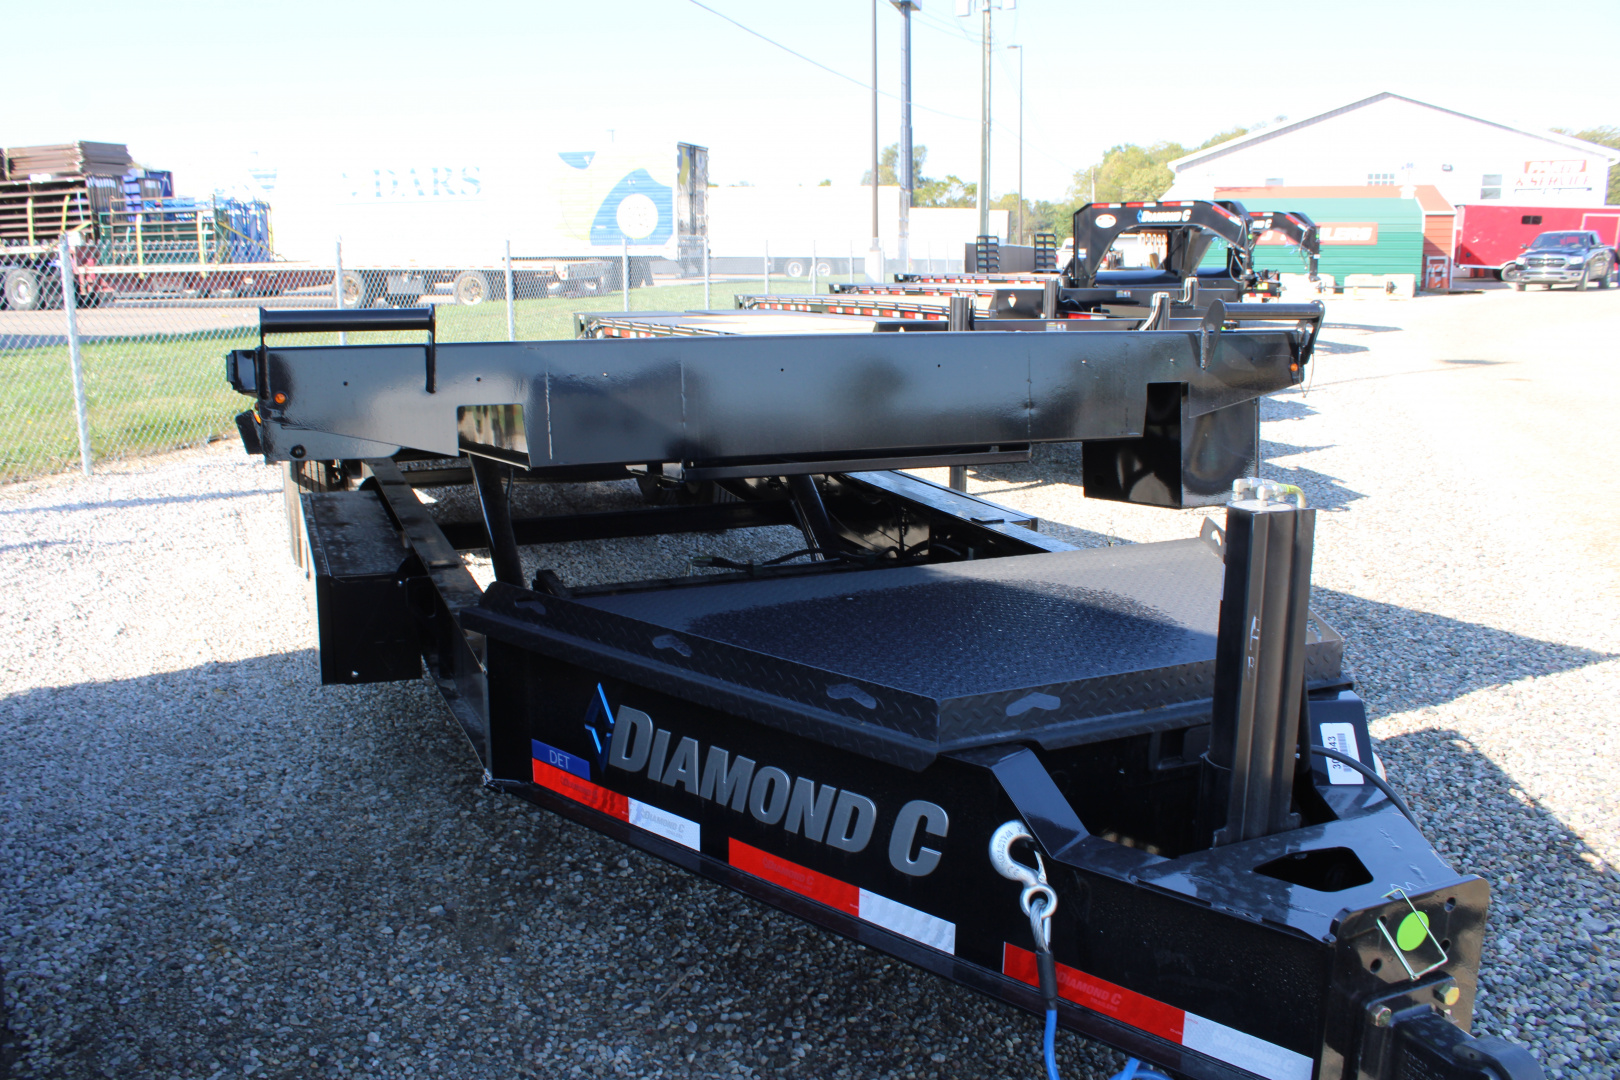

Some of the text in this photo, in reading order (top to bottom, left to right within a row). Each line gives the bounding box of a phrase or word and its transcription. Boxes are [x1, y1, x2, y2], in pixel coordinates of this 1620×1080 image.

[1182, 208, 1192, 222] C
[549, 749, 571, 770] DET
[608, 704, 949, 877] DIAMOND C
[1057, 972, 1123, 1006] DIAMOND C
